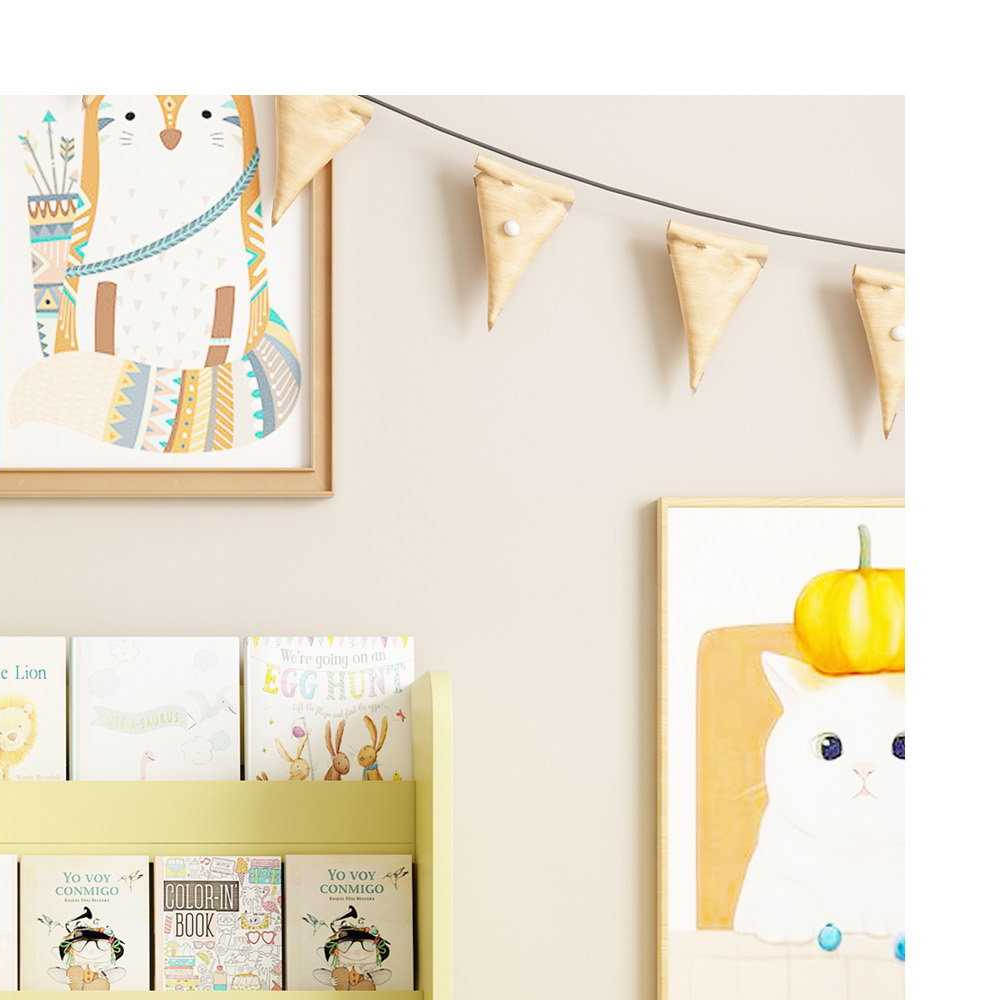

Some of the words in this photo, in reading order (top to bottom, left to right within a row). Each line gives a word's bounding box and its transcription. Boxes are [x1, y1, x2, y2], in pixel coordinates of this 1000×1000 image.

[281, 648, 312, 663] We're
[315, 653, 349, 669] going
[352, 653, 368, 665] on
[371, 651, 386, 662] an
[15, 665, 47, 680] Lion
[262, 663, 318, 700] EGG
[326, 662, 406, 701] HUNT
[101, 711, 179, 731] CUTE-A-SAURUS
[63, 872, 81, 883] YO
[328, 869, 346, 881] YO
[55, 886, 119, 896] CONMIGO
[165, 883, 238, 910] COLOR-IN'
[320, 884, 384, 894] CONMIGO
[175, 912, 215, 938] BOOK
